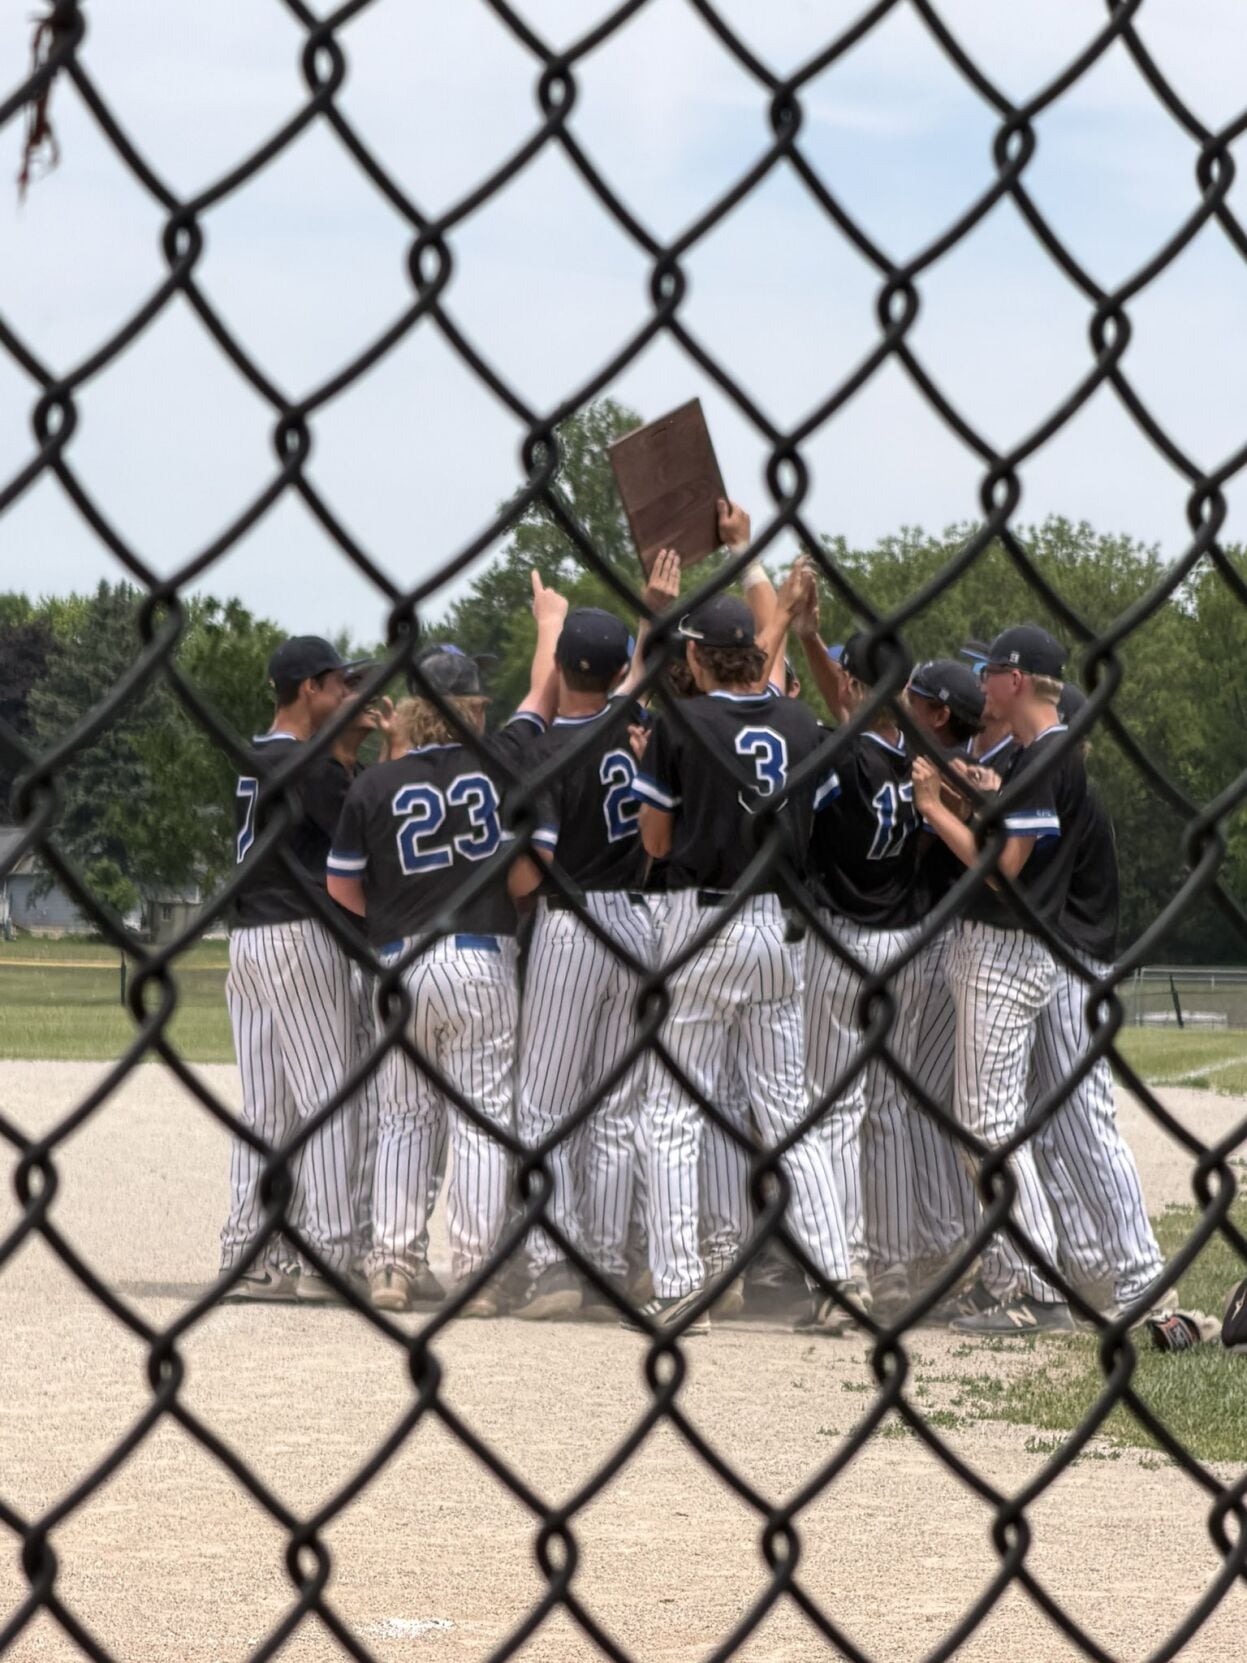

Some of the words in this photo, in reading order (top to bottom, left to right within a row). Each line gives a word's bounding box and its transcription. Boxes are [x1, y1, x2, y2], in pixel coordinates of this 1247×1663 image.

[735, 725, 788, 814] 3
[236, 776, 259, 864] 7
[392, 771, 500, 875] 23
